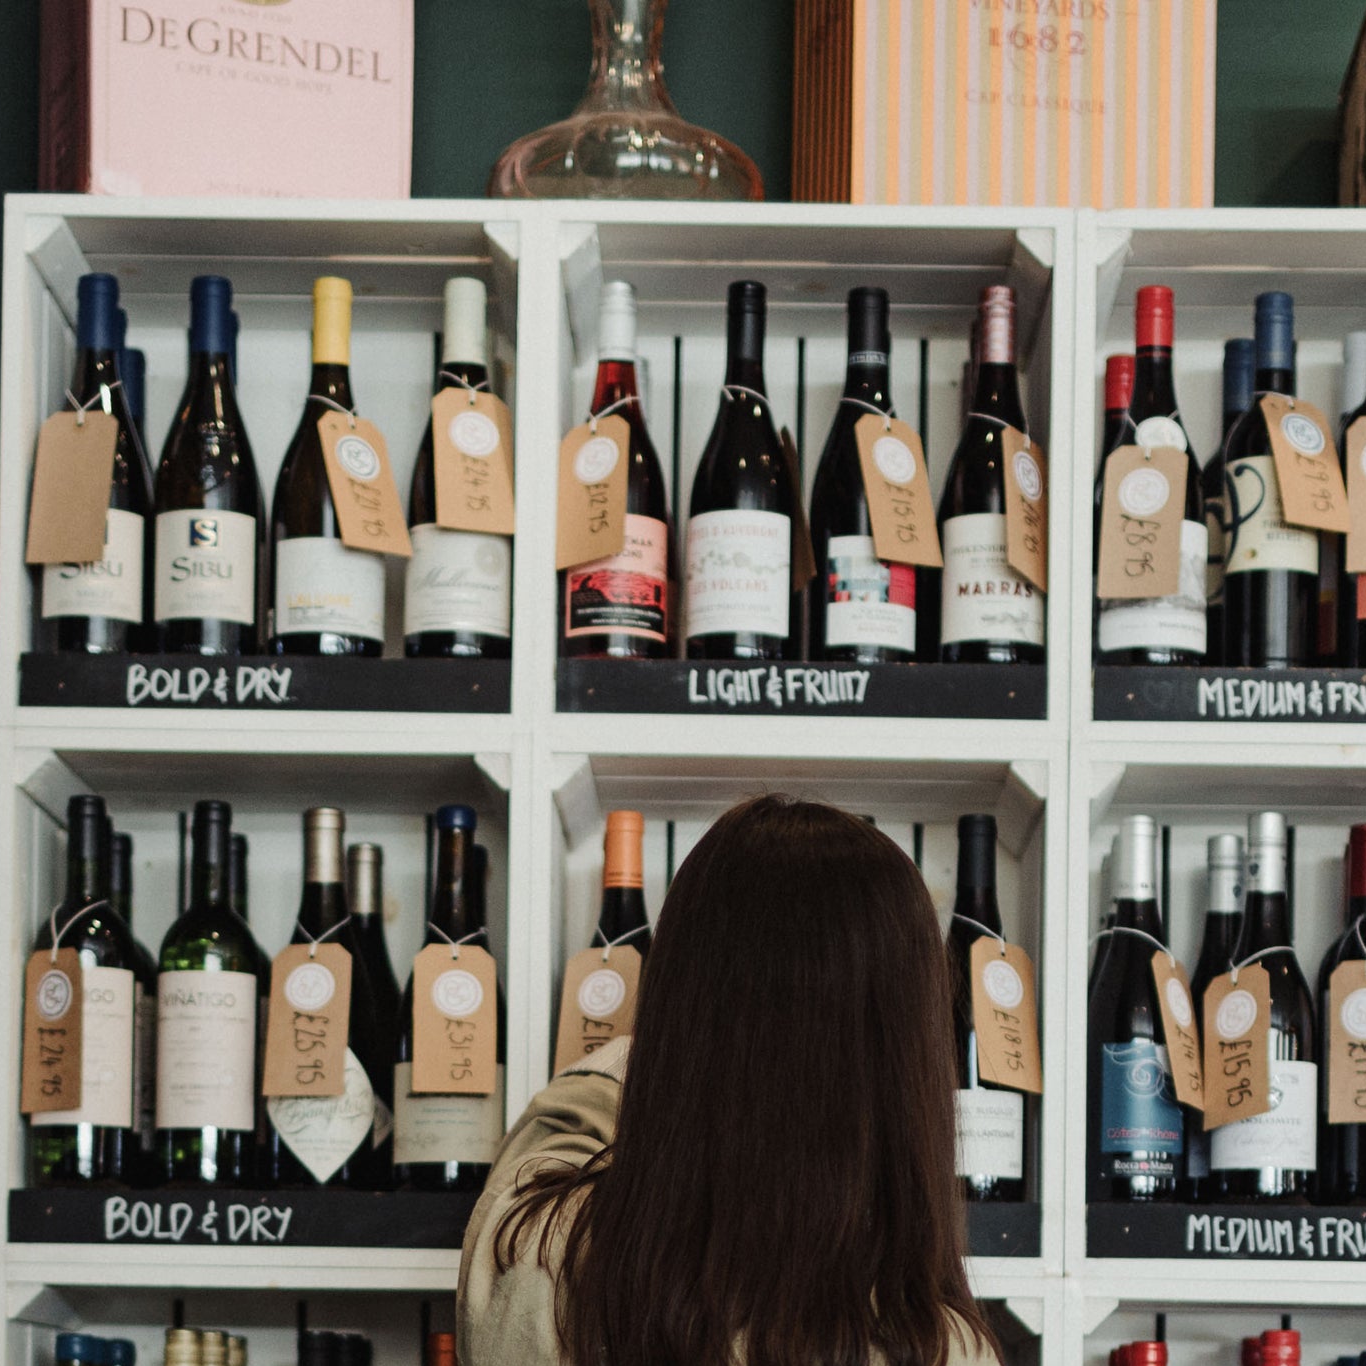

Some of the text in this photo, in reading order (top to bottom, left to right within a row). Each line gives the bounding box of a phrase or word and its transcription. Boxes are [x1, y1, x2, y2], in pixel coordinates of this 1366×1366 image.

[988, 23, 1087, 55] 1682
[958, 580, 1035, 600] MARRAS
[124, 664, 292, 709] BOLD & DRY
[689, 666, 869, 706] LIGHT & FRUITY
[1198, 678, 1309, 716] MEDIUM
[1308, 680, 1323, 715] &
[102, 1196, 295, 1247] BOLD & DRY
[1183, 1215, 1294, 1260] MEDIUM
[1299, 1218, 1315, 1262] &
